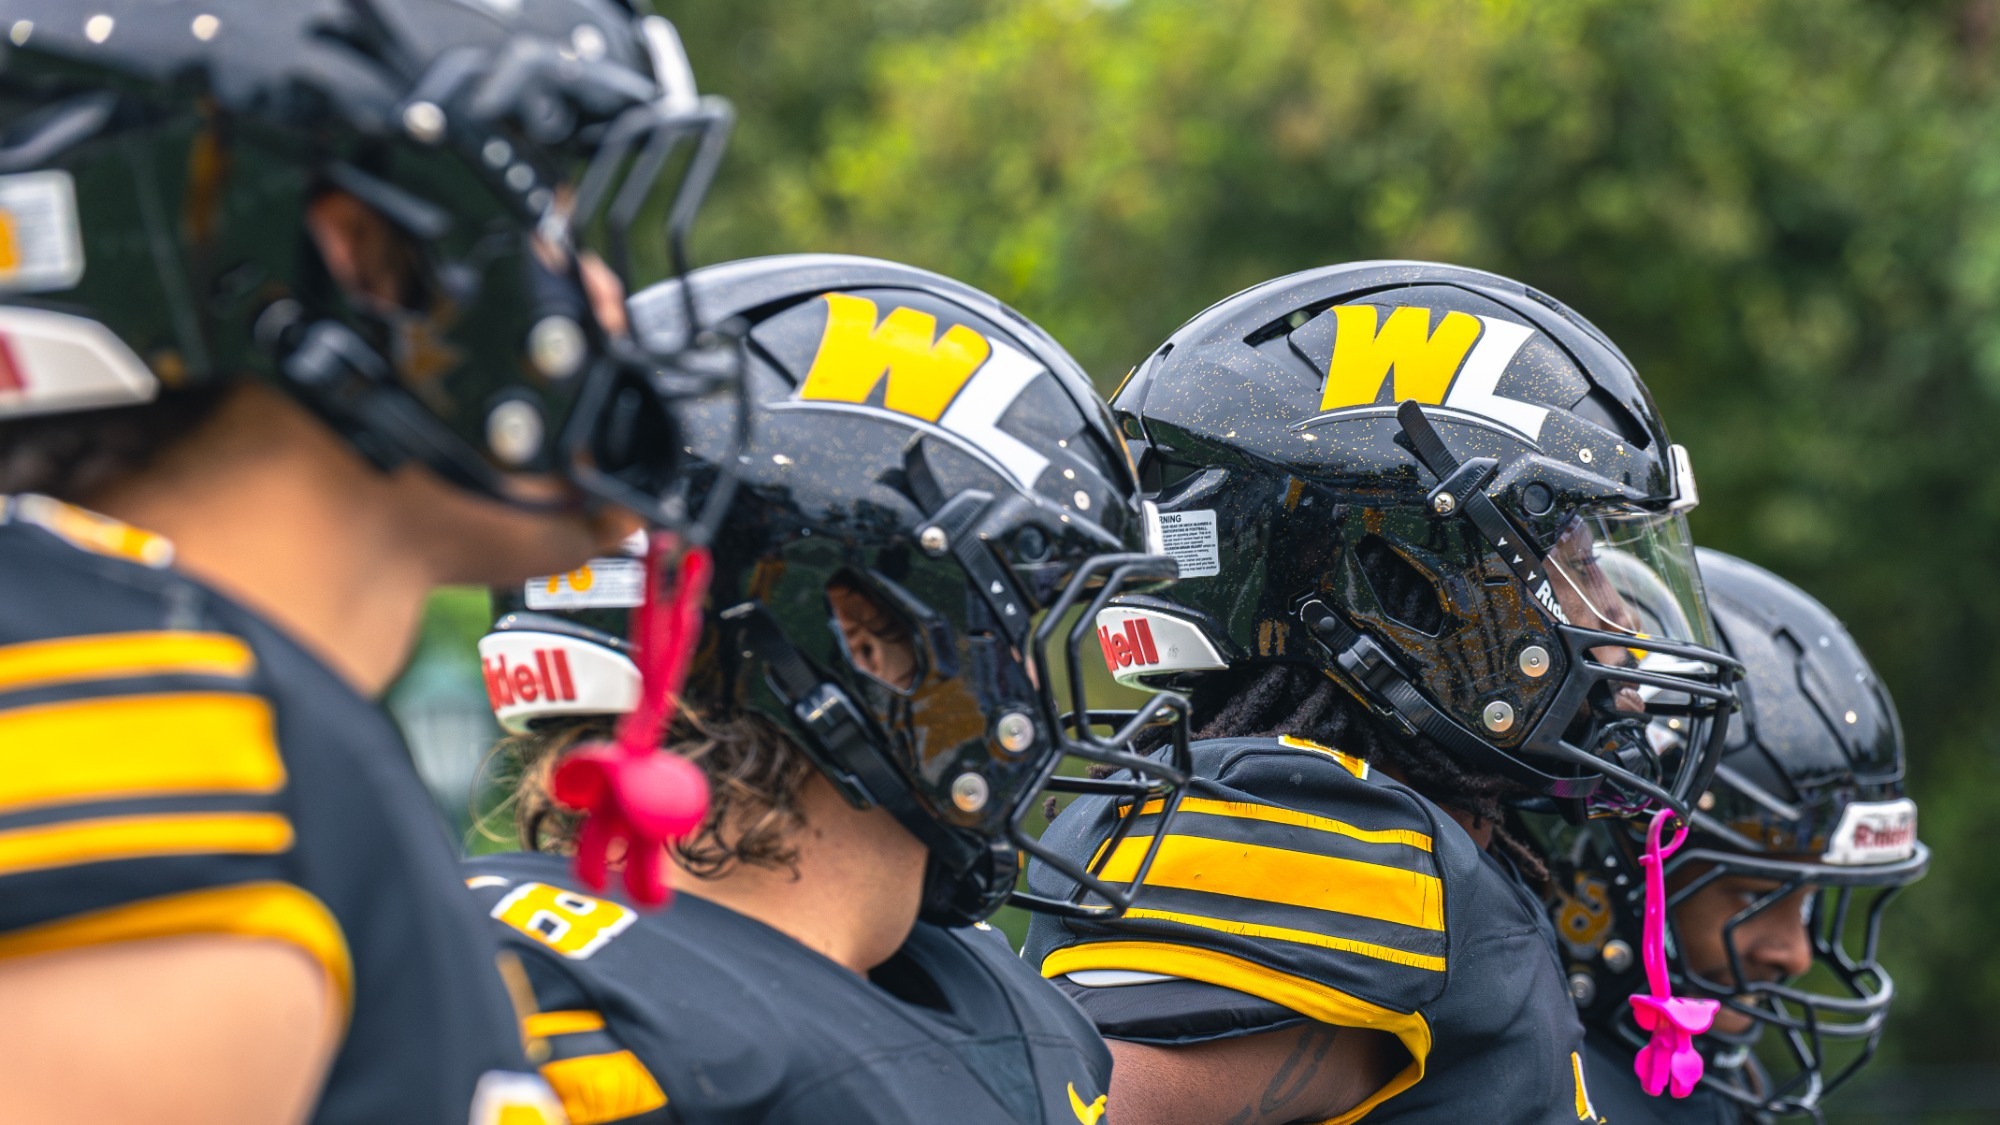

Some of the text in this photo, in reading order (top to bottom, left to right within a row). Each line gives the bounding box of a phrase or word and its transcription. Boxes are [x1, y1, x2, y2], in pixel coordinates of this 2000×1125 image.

[798, 292, 1051, 491] WL
[1319, 304, 1550, 443] WL
[482, 649, 576, 711] dell
